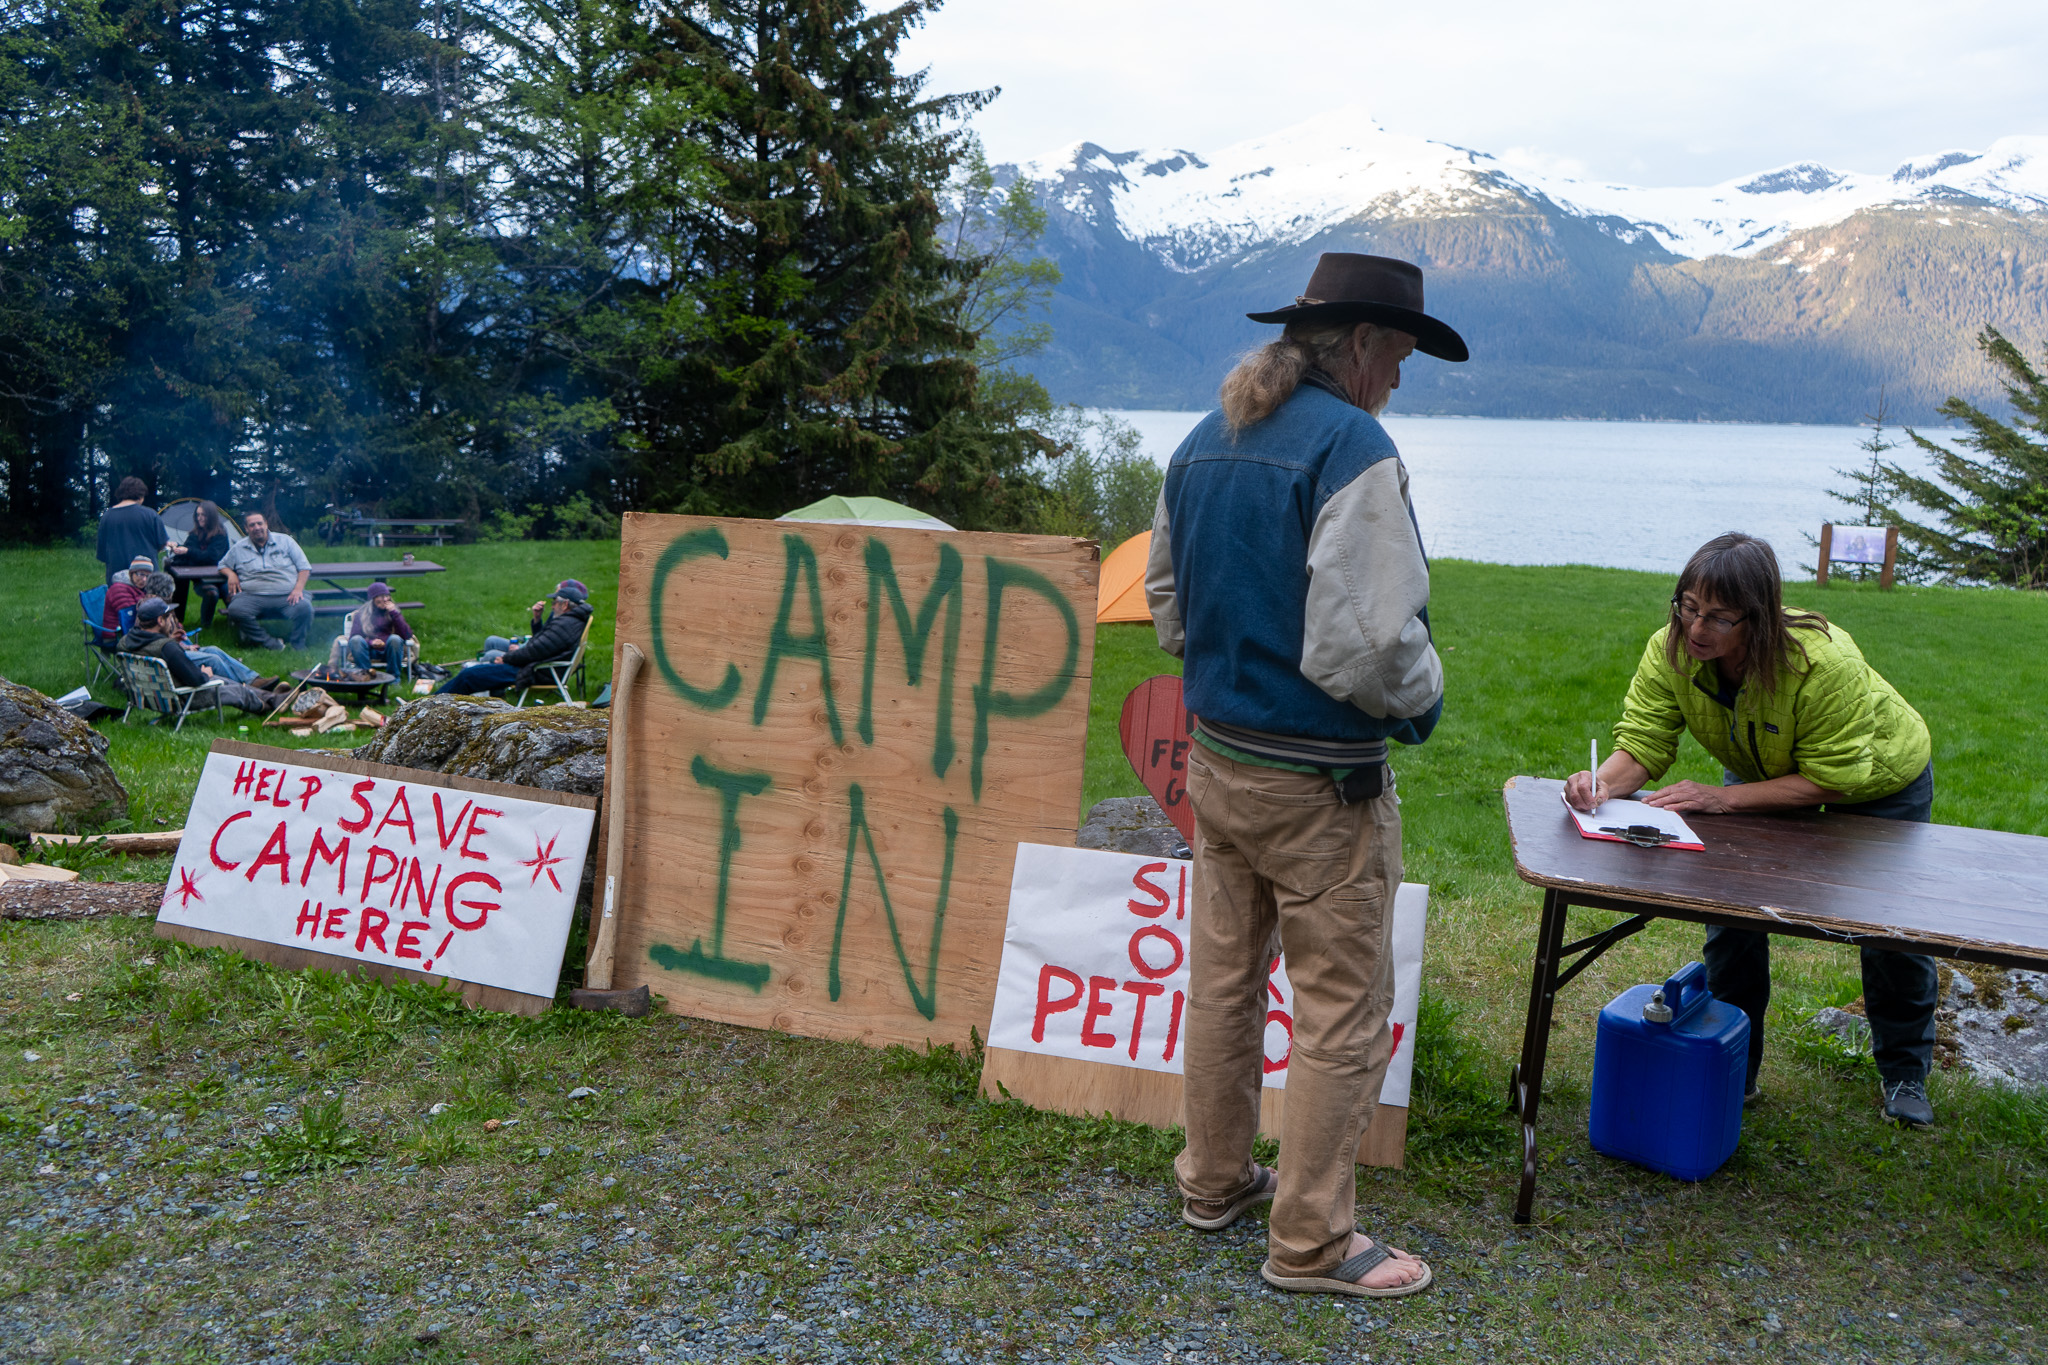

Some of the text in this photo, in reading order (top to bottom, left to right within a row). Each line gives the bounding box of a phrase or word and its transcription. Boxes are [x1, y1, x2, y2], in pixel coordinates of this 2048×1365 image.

[650, 527, 1080, 804] CAMP
[233, 760, 504, 862] HELP SAVE
[209, 810, 502, 932] CAMPING
[649, 755, 958, 1021] IN
[1128, 862, 1186, 921] SI
[295, 899, 454, 972] HERE!
